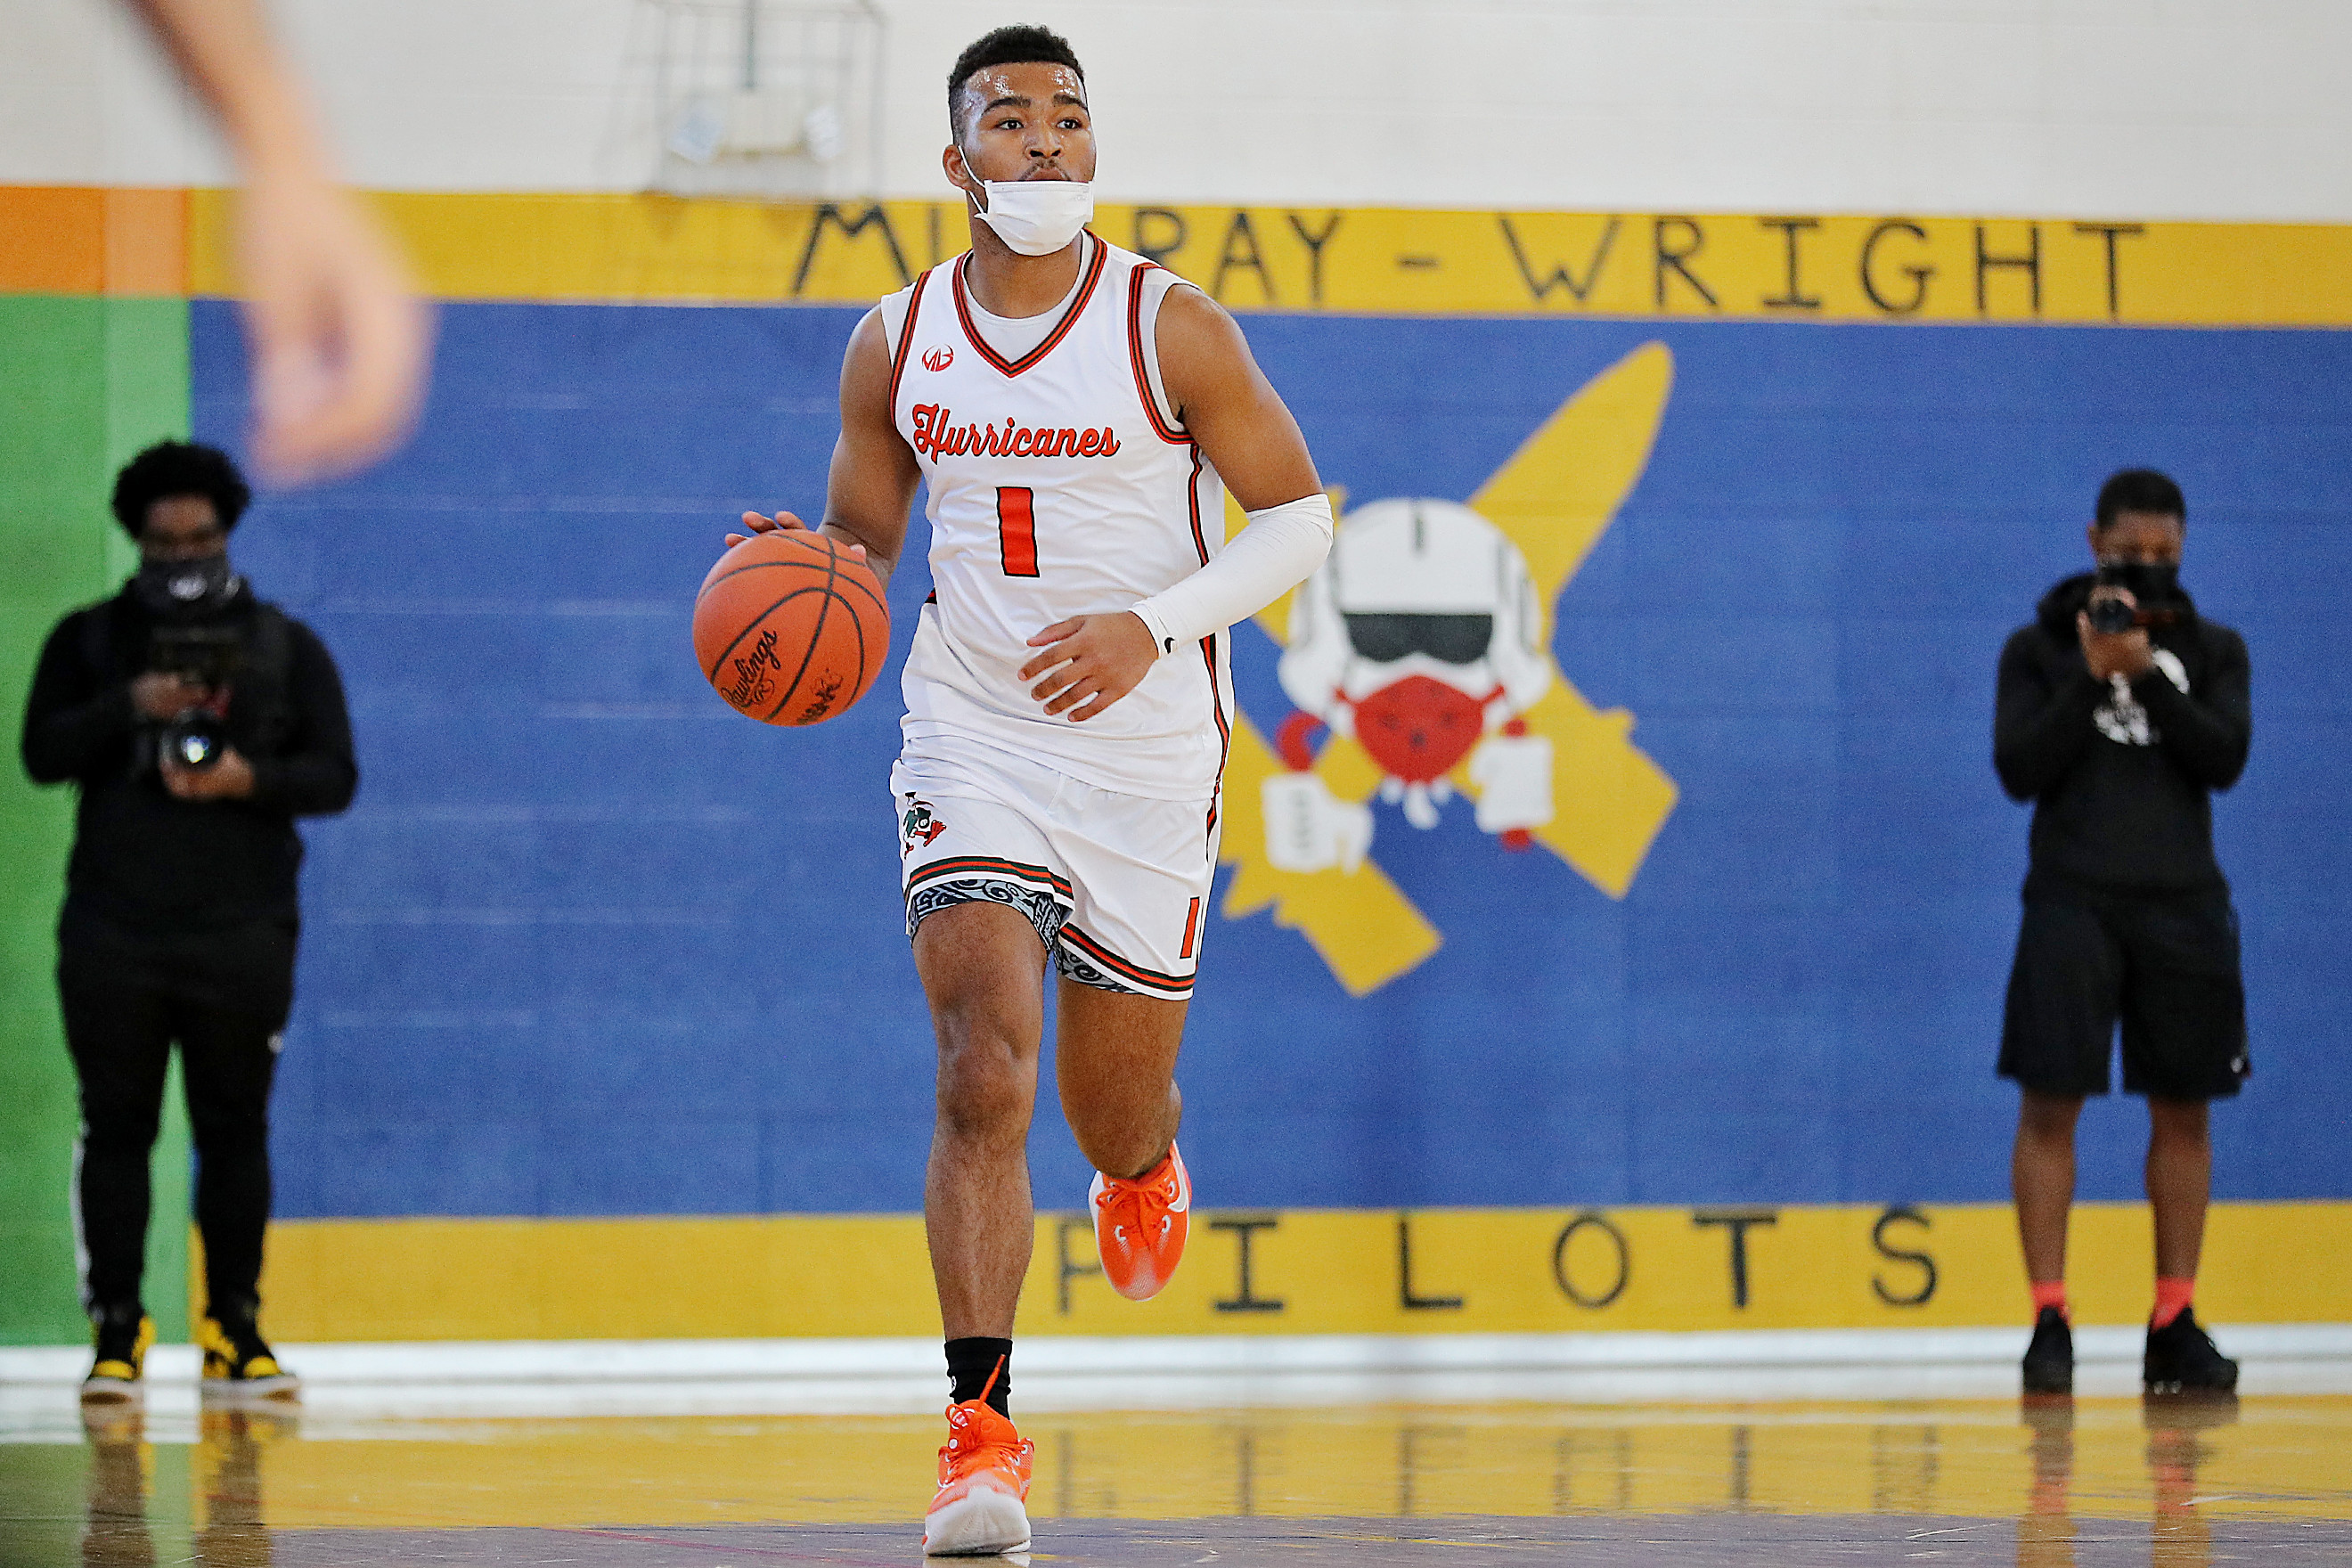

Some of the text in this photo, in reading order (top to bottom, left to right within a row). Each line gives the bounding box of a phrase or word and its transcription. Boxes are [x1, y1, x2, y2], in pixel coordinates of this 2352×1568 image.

[1498, 214, 2147, 323] WRIGHT
[912, 403, 1121, 465] Hurricanes
[995, 486, 1040, 577] 1
[1057, 1205, 1940, 1314] PILOTS
